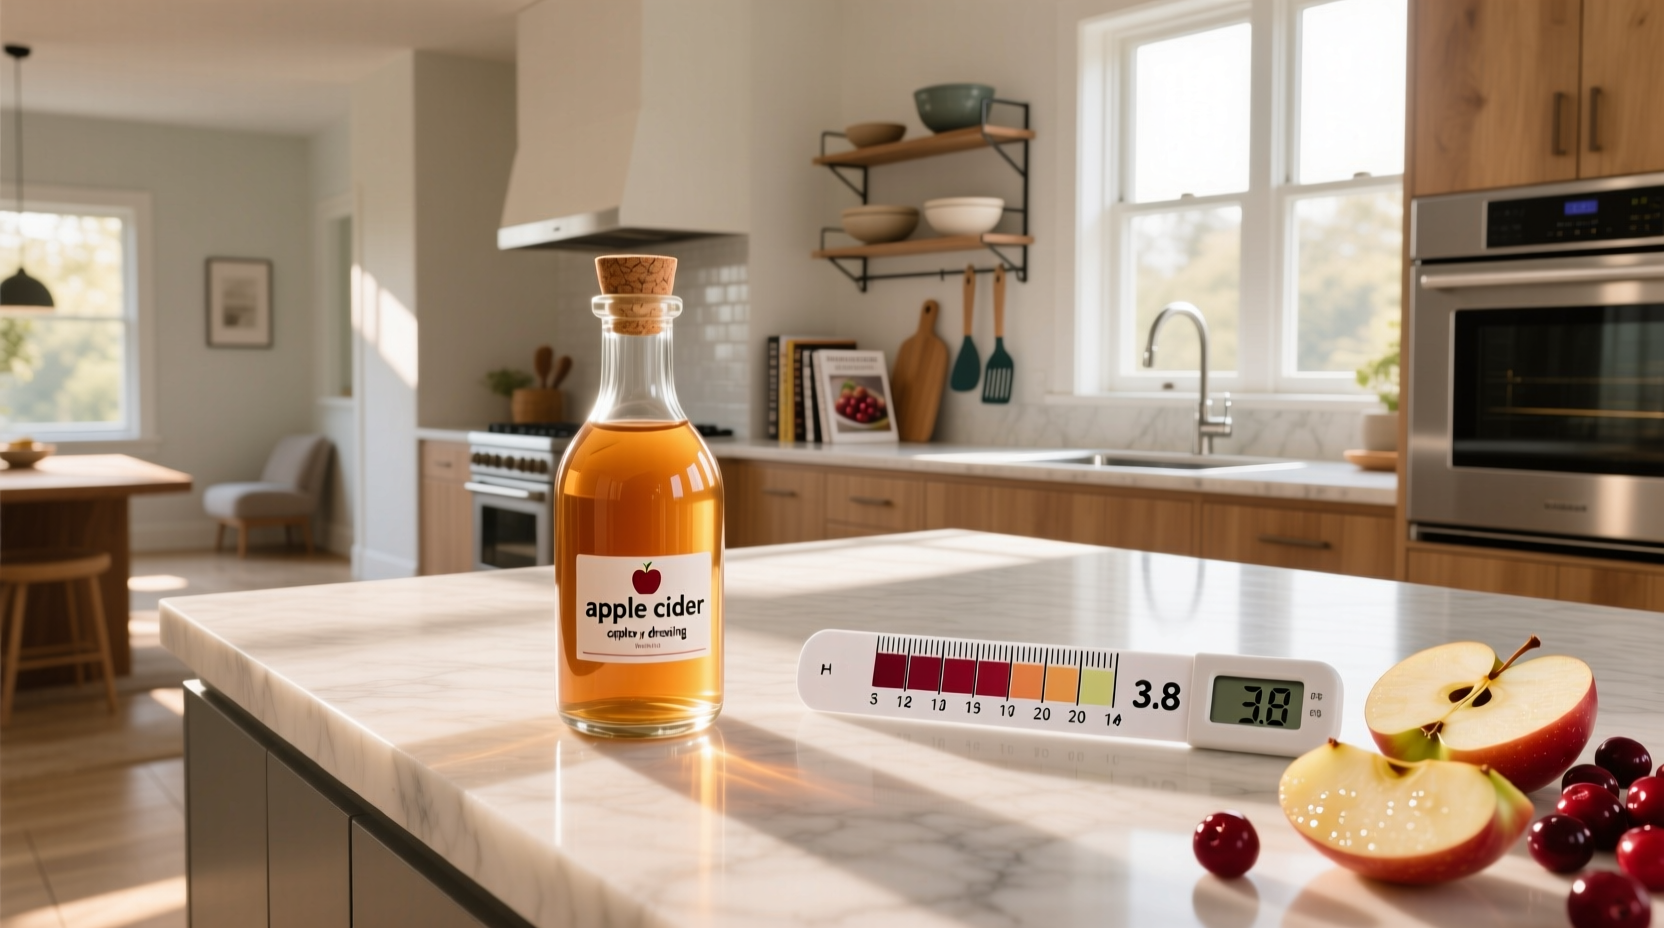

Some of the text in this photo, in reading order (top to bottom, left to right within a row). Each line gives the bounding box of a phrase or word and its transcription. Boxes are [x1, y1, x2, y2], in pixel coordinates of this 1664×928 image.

[585, 594, 705, 624] apple cider
[820, 663, 832, 675] H
[897, 695, 912, 708] 12
[1033, 707, 1051, 721] 20
[1068, 710, 1086, 724] 20
[1132, 679, 1181, 711] 3.8
[1238, 685, 1291, 726] 3.8
